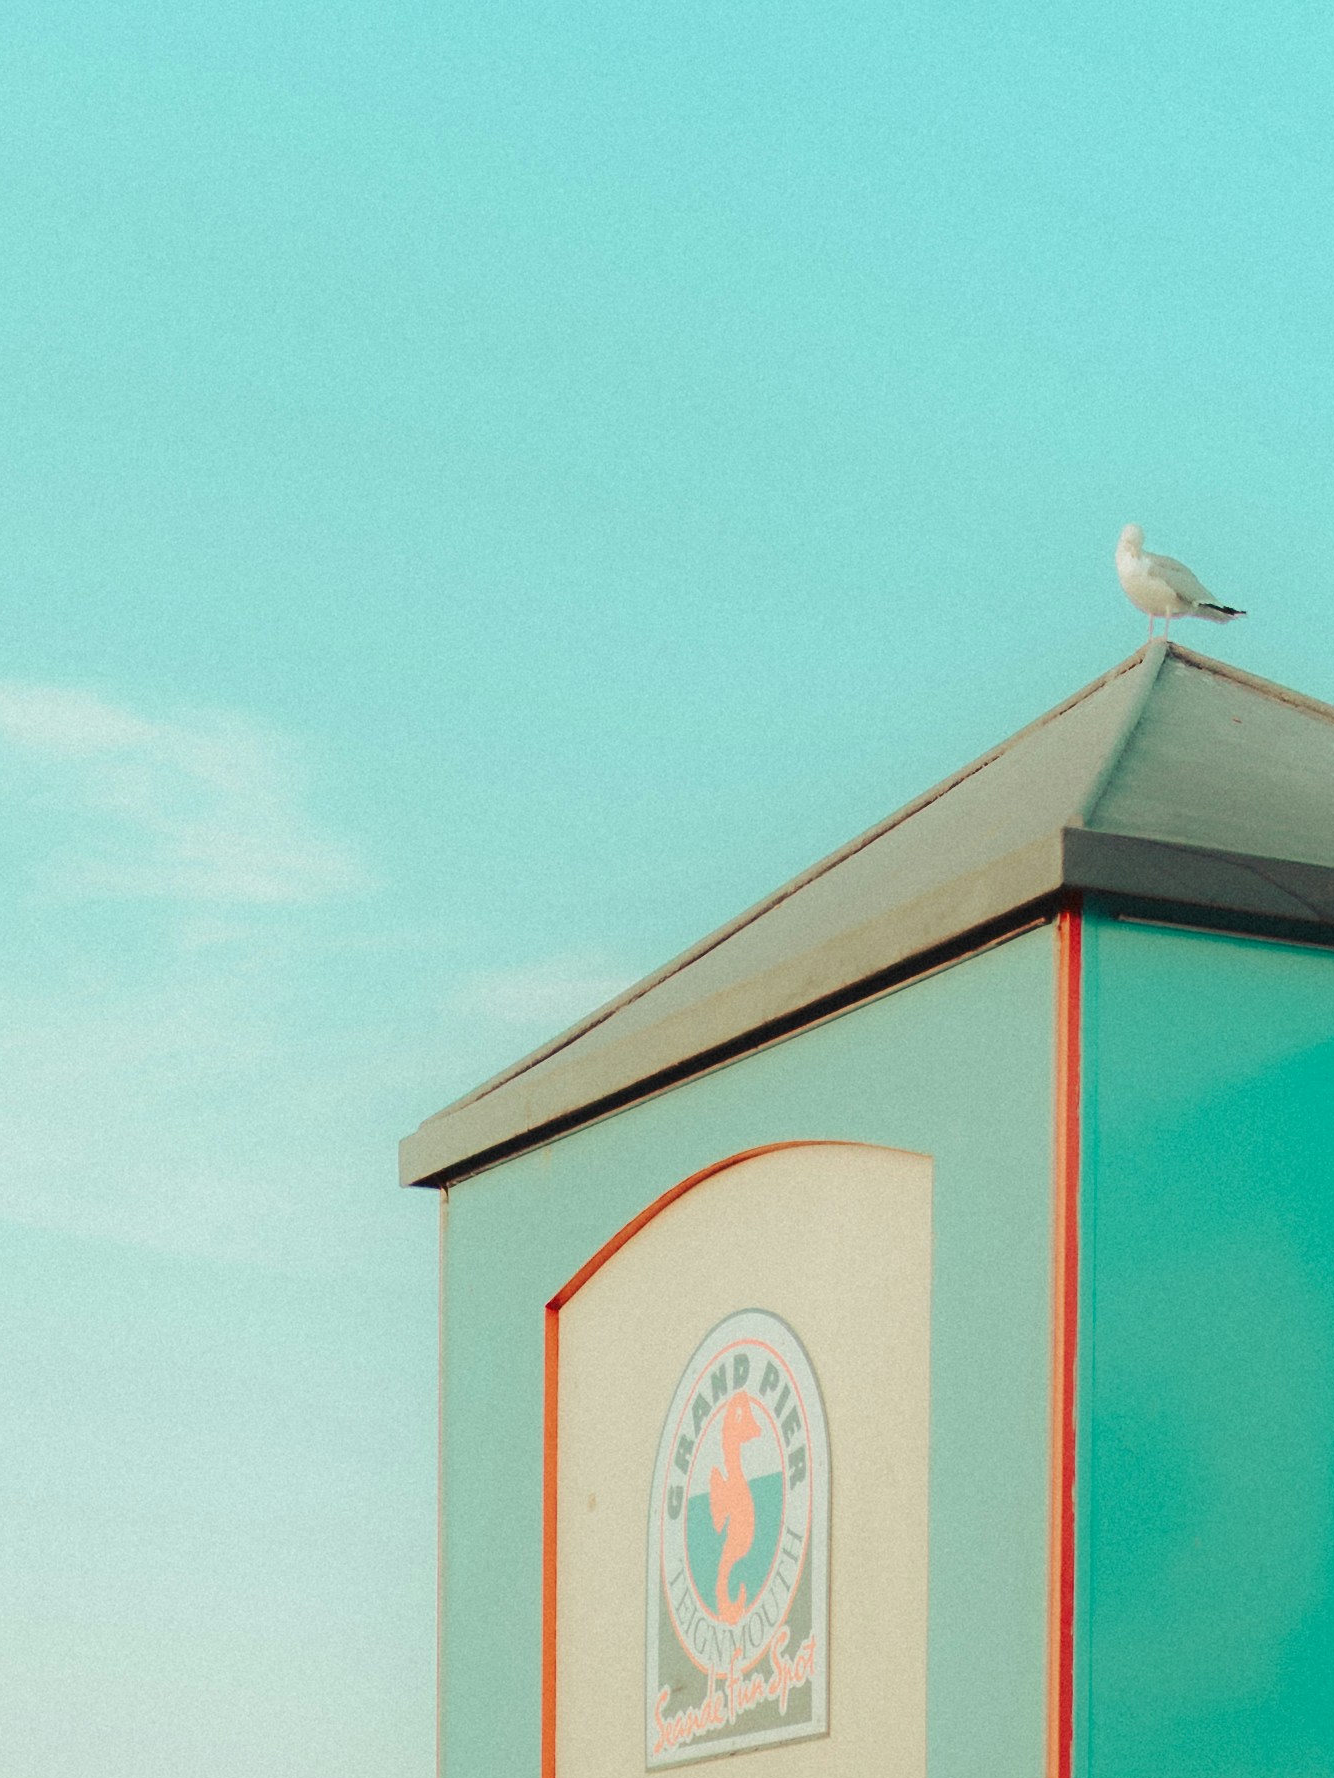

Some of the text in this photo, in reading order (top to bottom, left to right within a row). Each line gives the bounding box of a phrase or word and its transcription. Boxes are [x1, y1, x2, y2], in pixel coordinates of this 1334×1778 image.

[668, 1354, 806, 1519] GRAND PIER
[669, 1528, 803, 1667] TEIGNMOUTH
[727, 1647, 764, 1719] Fun
[768, 1630, 816, 1711] Spot
